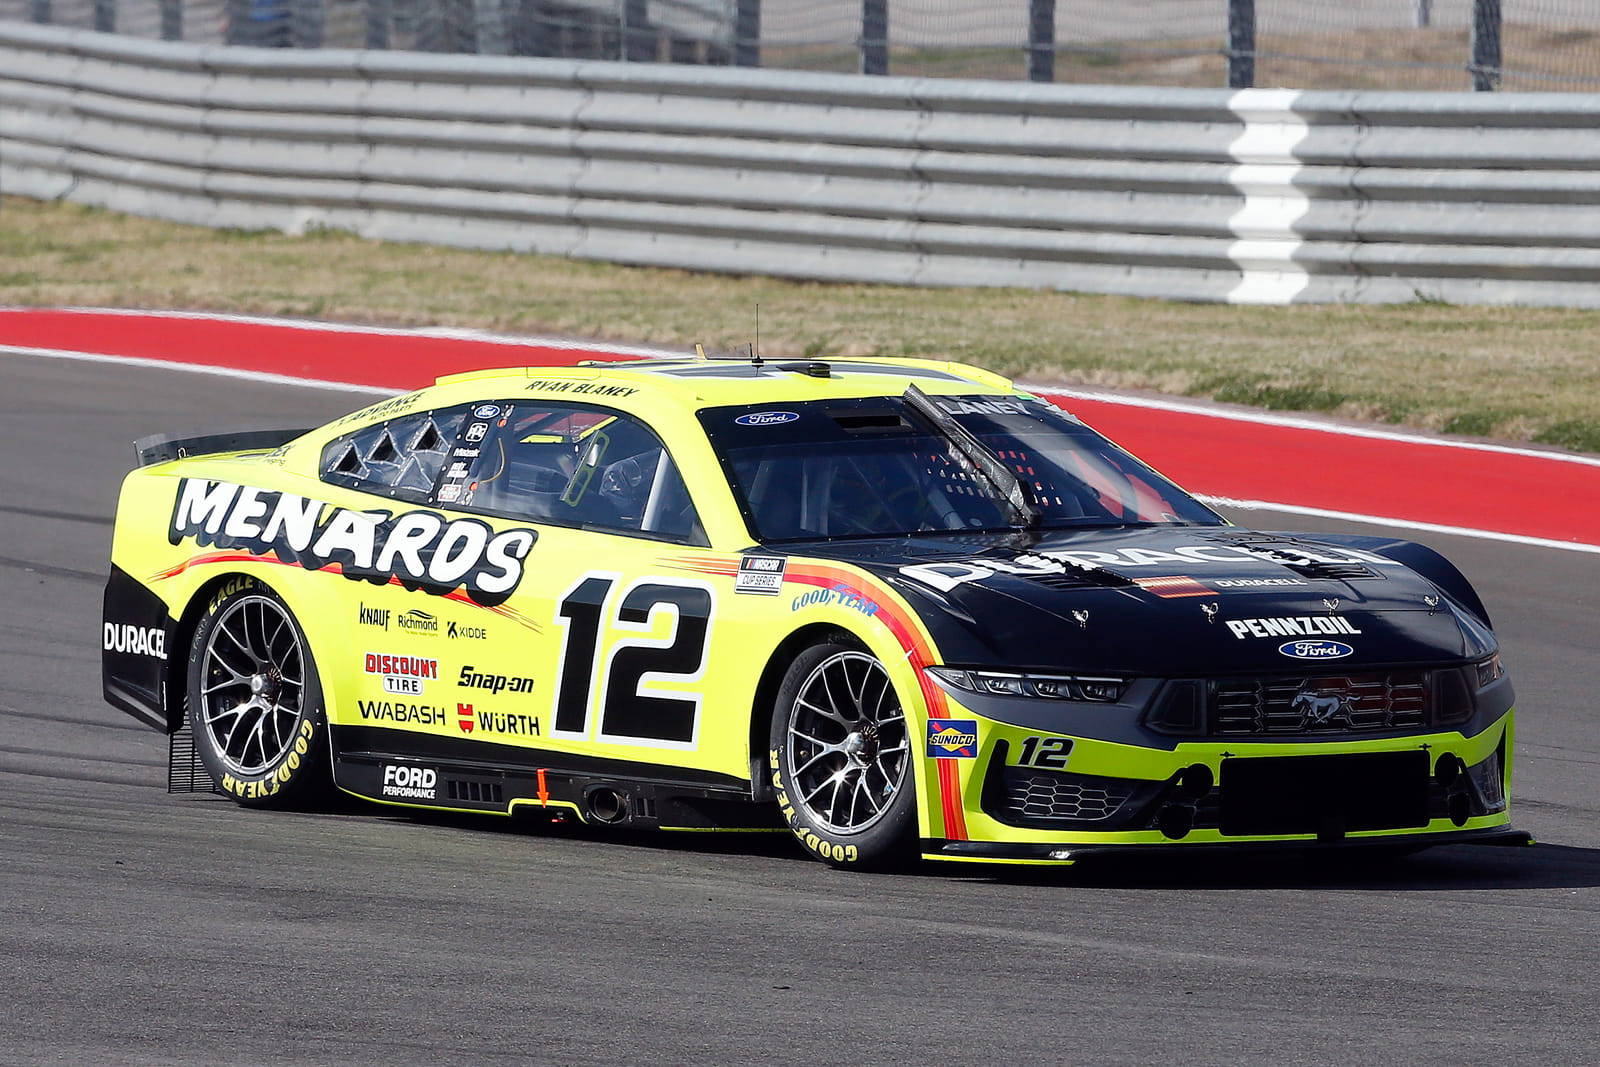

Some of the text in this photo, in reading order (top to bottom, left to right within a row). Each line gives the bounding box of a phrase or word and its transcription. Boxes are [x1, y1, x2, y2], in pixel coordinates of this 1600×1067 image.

[524, 380, 640, 398] RYAN BLANEY
[743, 412, 793, 425] Ford
[170, 477, 536, 603] MENARDS
[751, 558, 781, 572] NASCAR
[742, 574, 777, 587] CUP SERIES
[1214, 579, 1309, 588] DURACELL
[208, 576, 254, 617] EAGLE
[791, 583, 879, 617] GOODYEAR
[398, 614, 438, 631] Richmond
[1225, 616, 1362, 640] PENNZOIL
[459, 626, 487, 640] KIDDE
[1289, 641, 1346, 658] Ford
[365, 653, 437, 679] DISCOUNT
[551, 573, 714, 747] 12
[386, 677, 419, 692] TIRE
[457, 665, 534, 695] Snap-on
[358, 700, 446, 726] WABASH
[478, 710, 540, 736] WÜRTH
[931, 735, 974, 746] SUNOCO
[1017, 736, 1075, 769] 12
[383, 765, 437, 788] FORD
[382, 785, 436, 799] PERFORMANCE
